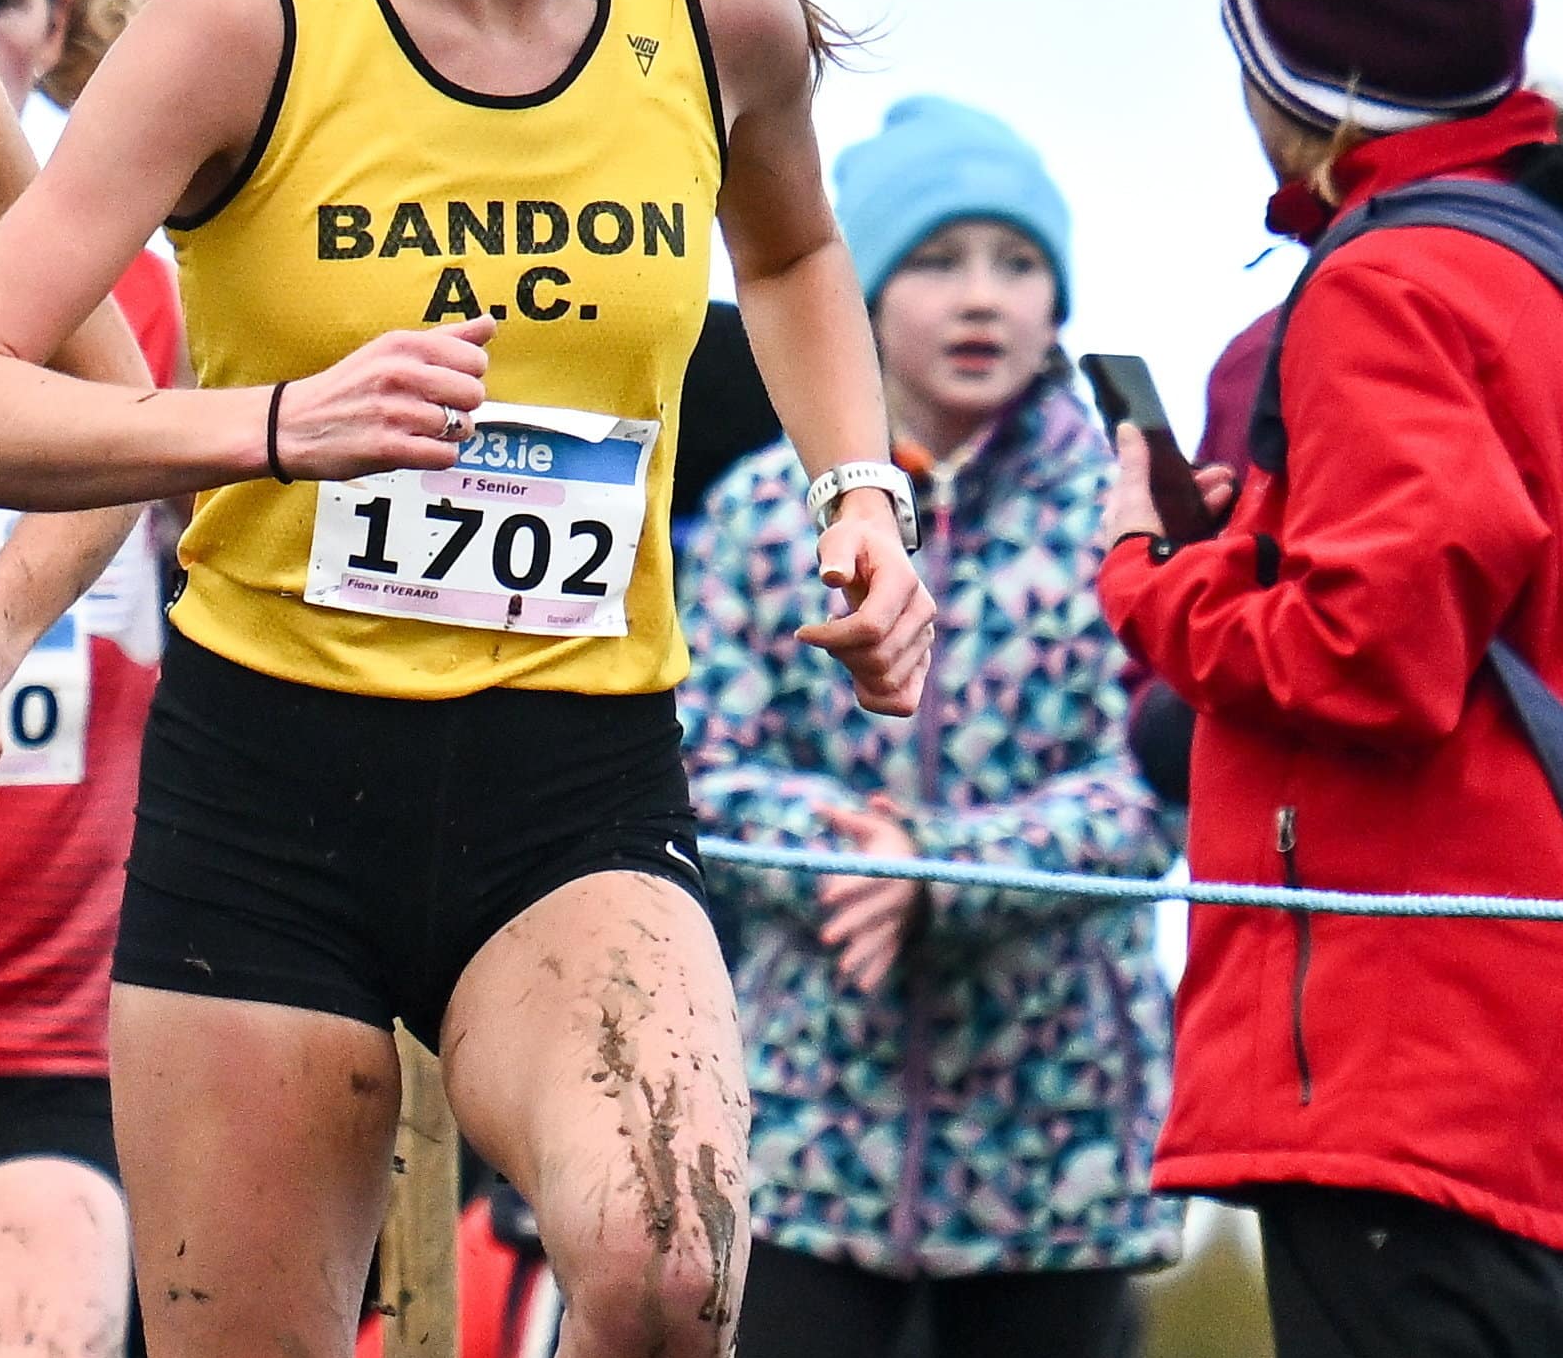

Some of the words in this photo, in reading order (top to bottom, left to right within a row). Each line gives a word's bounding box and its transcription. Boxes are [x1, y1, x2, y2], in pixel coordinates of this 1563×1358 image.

[317, 201, 686, 261] BANDON
[422, 266, 598, 323] A.C.
[458, 429, 554, 472] 23.ie
[461, 477, 472, 489] F
[476, 478, 529, 496] Senior
[347, 496, 614, 597] 1702
[347, 578, 380, 592] Fiona
[382, 583, 439, 600] EVERARD
